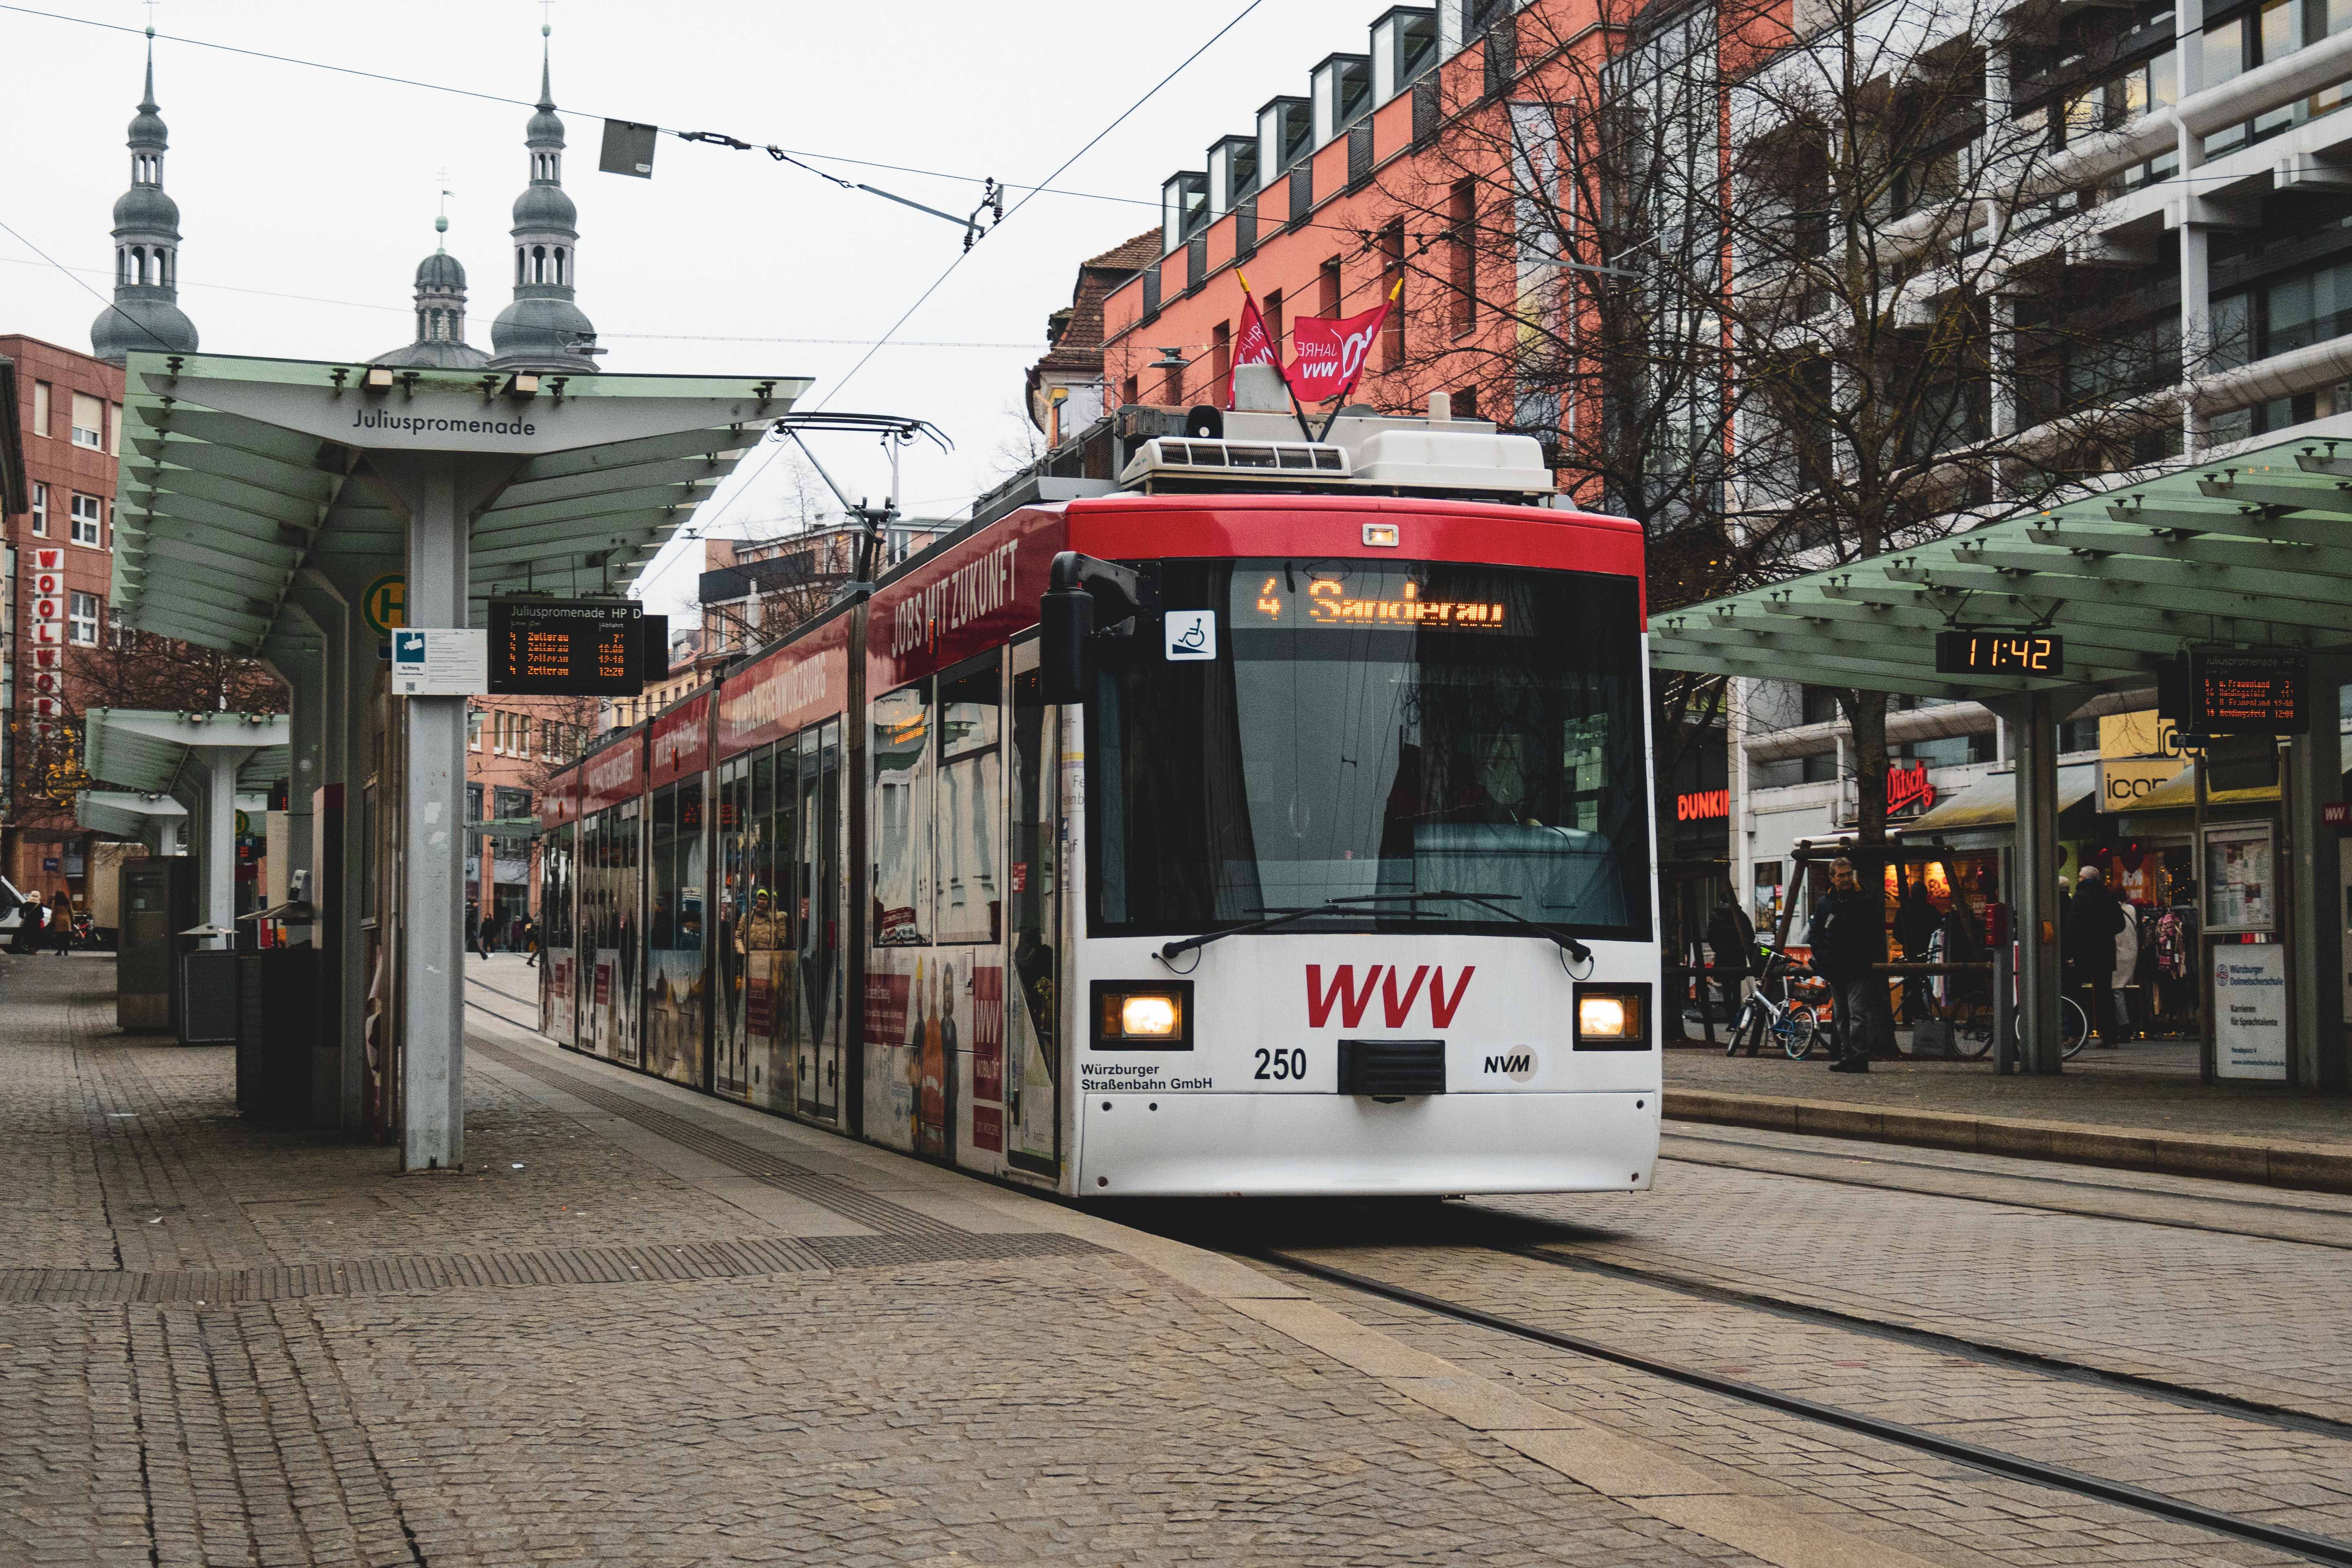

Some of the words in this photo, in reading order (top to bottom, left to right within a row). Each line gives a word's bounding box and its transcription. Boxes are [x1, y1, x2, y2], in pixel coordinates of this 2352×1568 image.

[352, 408, 535, 435] Juliuspromenade
[891, 592, 922, 658] JOBS
[925, 577, 949, 642] MIT
[951, 538, 1018, 629] ZUKUNFT
[1257, 577, 1280, 620] 4
[1310, 580, 1503, 627] Sanderau
[511, 605, 605, 620] Juliuspromenade
[612, 608, 627, 618] HP
[633, 609, 642, 619] D
[528, 632, 569, 642] Zellerau
[1970, 639, 2051, 669] 11:42
[2206, 655, 2278, 667] Juliuspromenade
[528, 666, 569, 675] Zellerau
[2229, 680, 2270, 688] Frauenland
[1887, 760, 1924, 804] Ditsch
[2230, 965, 2264, 975] Würzburger
[2230, 977, 2283, 985] Dolmetscherschule
[1306, 964, 1476, 1028] WVV
[2230, 1004, 2256, 1013] Karrieren
[2230, 1017, 2239, 1026] für
[2240, 1017, 2278, 1027] Sprachtalente
[1081, 1064, 1159, 1076] Würzburger
[1254, 1048, 1307, 1080] 250
[1484, 1055, 1530, 1073] NVM
[1081, 1078, 1166, 1090] Straßenbahn
[1170, 1078, 1212, 1089] GmbH
